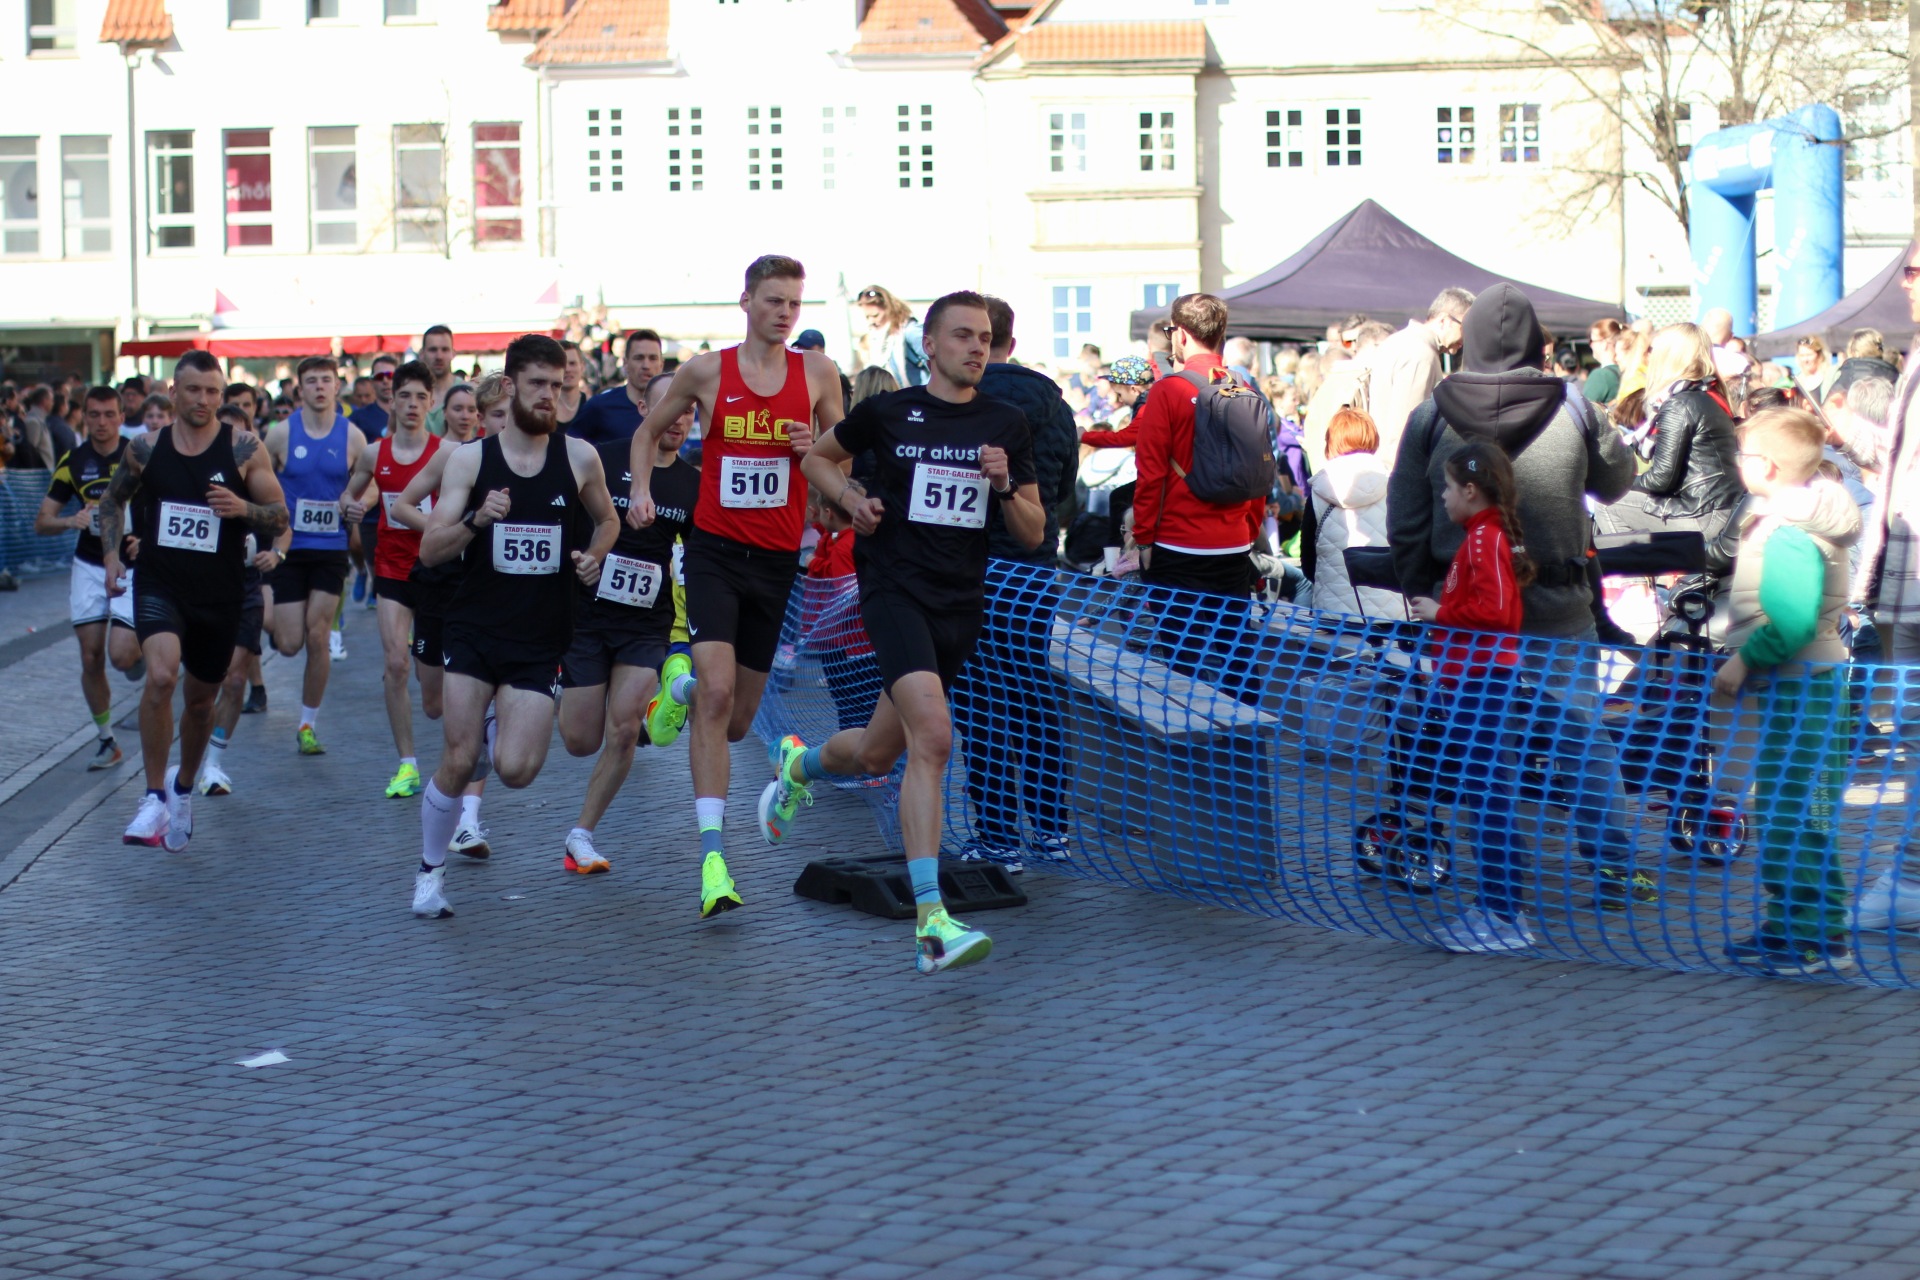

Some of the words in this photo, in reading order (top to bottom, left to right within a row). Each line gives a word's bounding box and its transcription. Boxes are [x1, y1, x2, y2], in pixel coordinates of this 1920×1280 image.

[731, 459, 779, 467] STADT-GALERIE
[895, 445, 926, 458] car
[930, 446, 983, 461] akust
[927, 467, 981, 480] STADT-GALERIE
[731, 472, 779, 496] 510
[925, 482, 978, 513] 512
[302, 509, 333, 525] 840
[168, 516, 209, 540] 526
[504, 526, 552, 534] STADT-GALERIE
[504, 539, 551, 563] 536
[611, 569, 652, 596] 513
